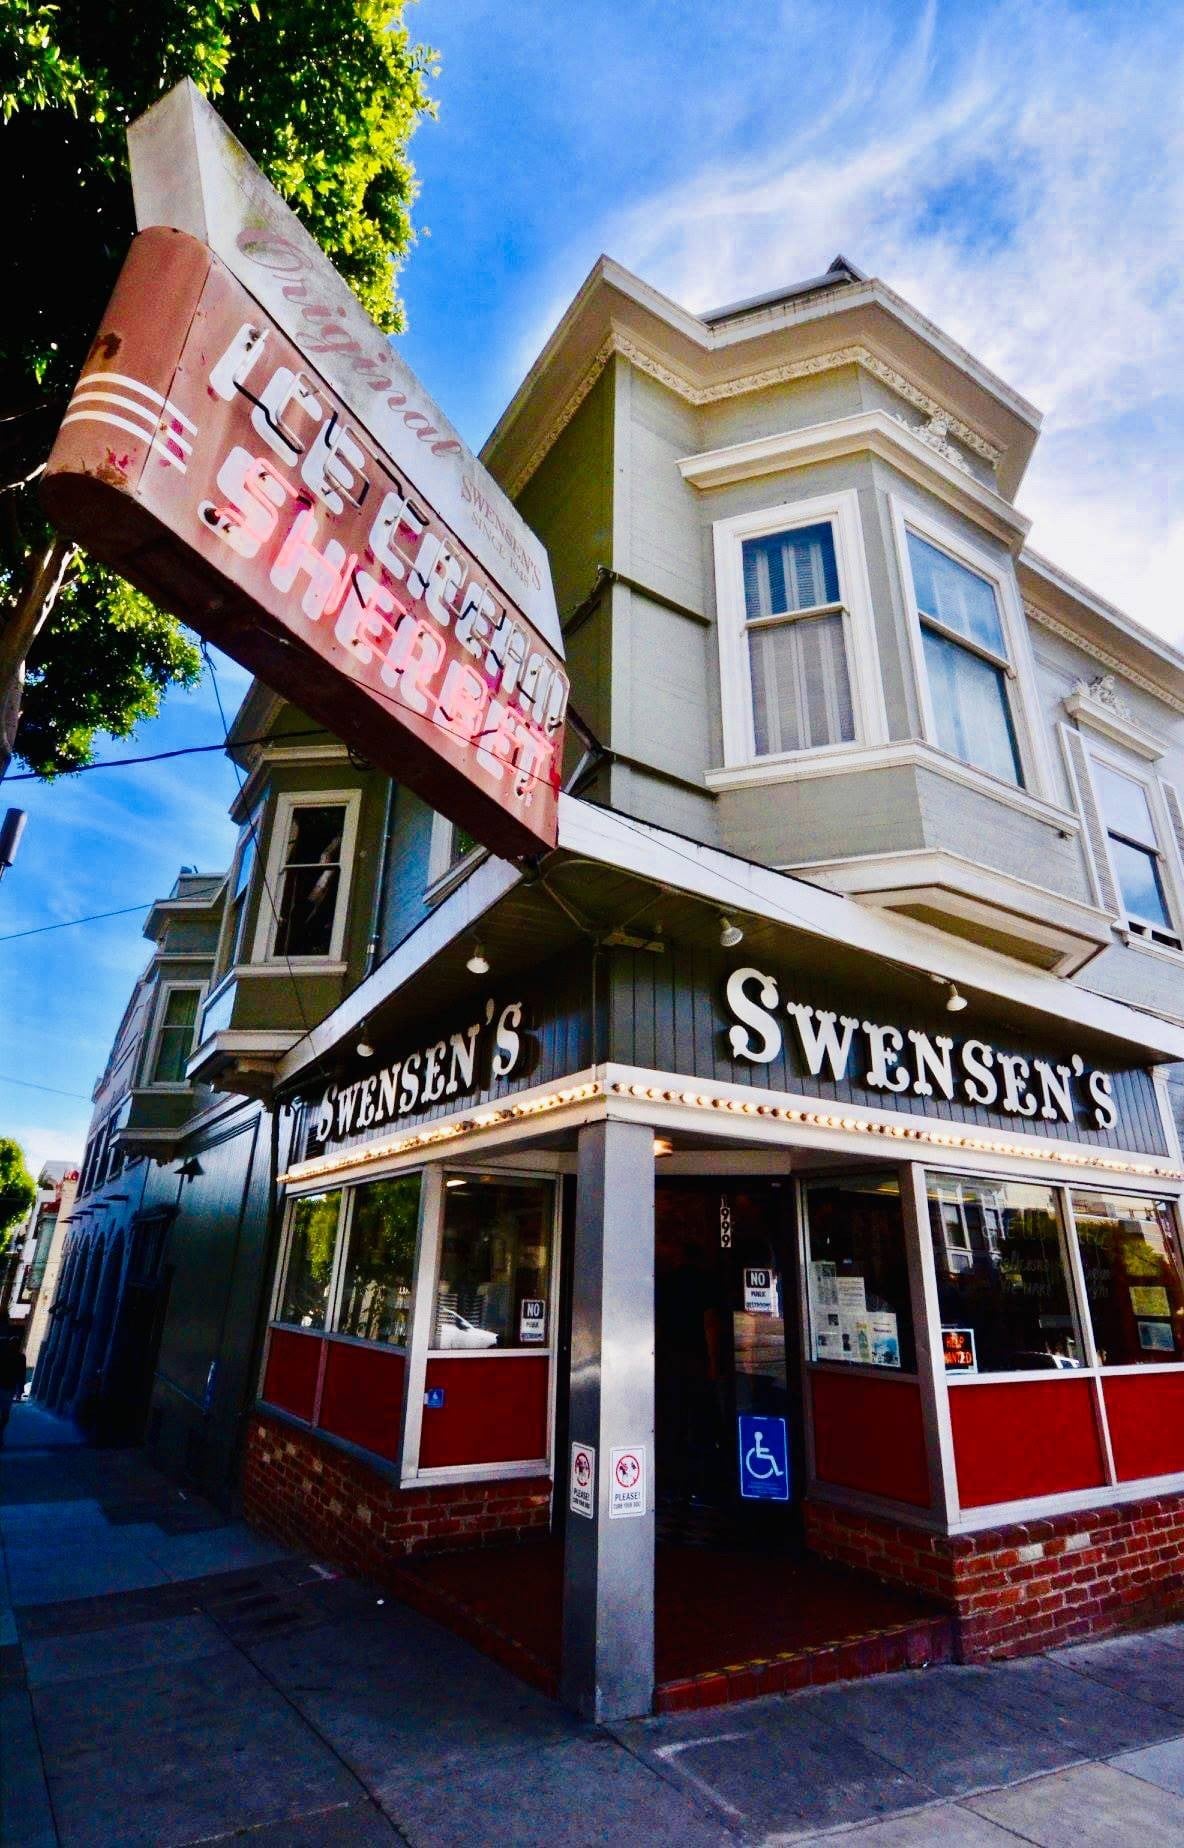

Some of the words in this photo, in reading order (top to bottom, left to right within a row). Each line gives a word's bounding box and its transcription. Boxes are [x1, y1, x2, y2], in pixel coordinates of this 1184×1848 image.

[235, 220, 462, 457] Original
[208, 323, 370, 515] ICE
[368, 490, 569, 737] CREAM
[197, 446, 553, 798] SHERBET
[315, 998, 523, 1142] SWENSEN'S
[726, 967, 1118, 1130] SWENSEN'S
[527, 1303, 540, 1317] NO
[750, 1271, 766, 1287] NO
[615, 1491, 641, 1501] PLEASE!
